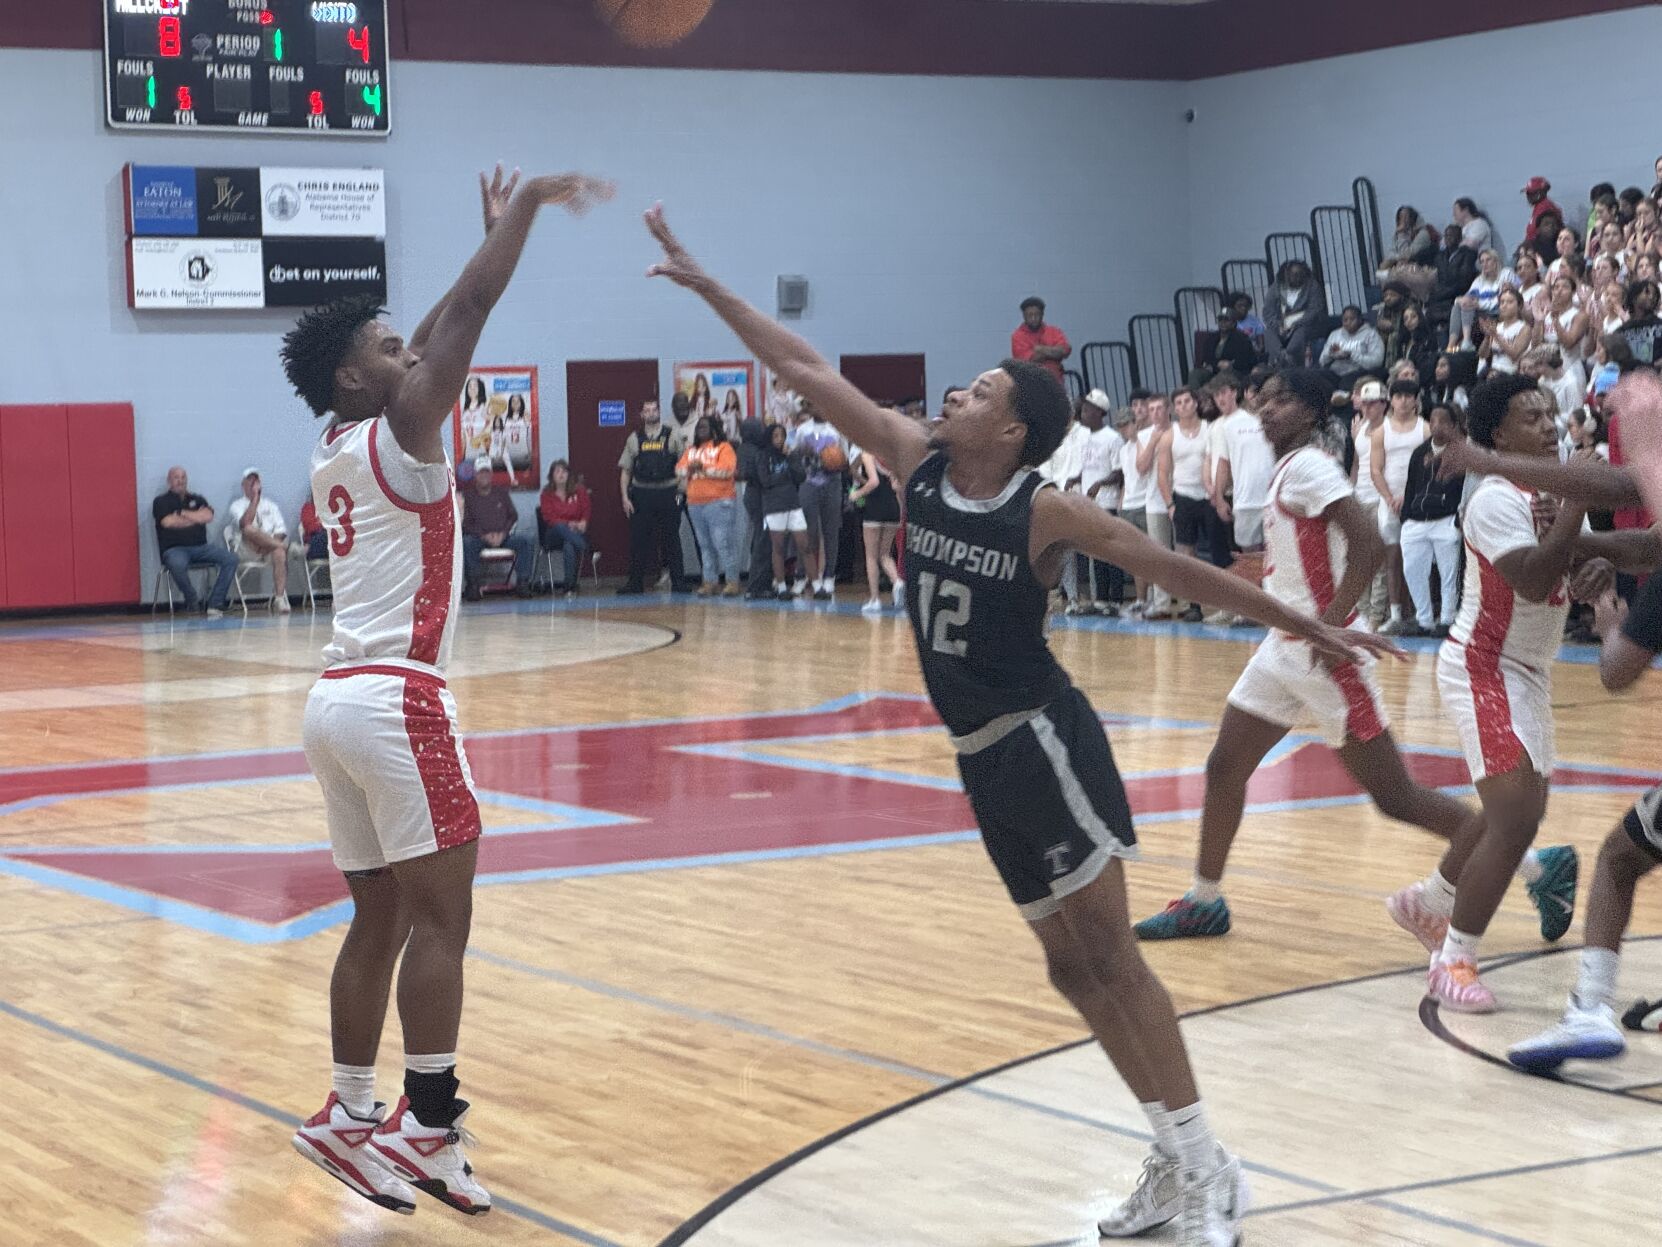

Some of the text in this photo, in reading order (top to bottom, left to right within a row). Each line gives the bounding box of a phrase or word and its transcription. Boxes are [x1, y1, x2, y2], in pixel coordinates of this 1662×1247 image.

[159, 16, 180, 56] 8
[216, 33, 260, 50] PERIOD
[274, 28, 282, 60] 1
[347, 25, 369, 63] 4
[117, 59, 154, 75] FOULS
[206, 63, 251, 79] PLAYER
[269, 65, 304, 82] FOULS
[345, 68, 380, 84] FOULS
[148, 75, 155, 108] 1
[363, 84, 381, 115] 4
[125, 107, 151, 122] WON
[173, 109, 198, 126] TOL
[238, 112, 269, 126] GAME
[306, 114, 329, 130] TOL
[351, 115, 375, 129] WON
[144, 186, 182, 198] EATON
[297, 182, 380, 193] CHRIS ENGLAND
[303, 268, 320, 280] on
[323, 265, 381, 283] yourself.
[136, 289, 157, 298] Mark
[328, 484, 354, 557] 3
[917, 570, 972, 657] 12
